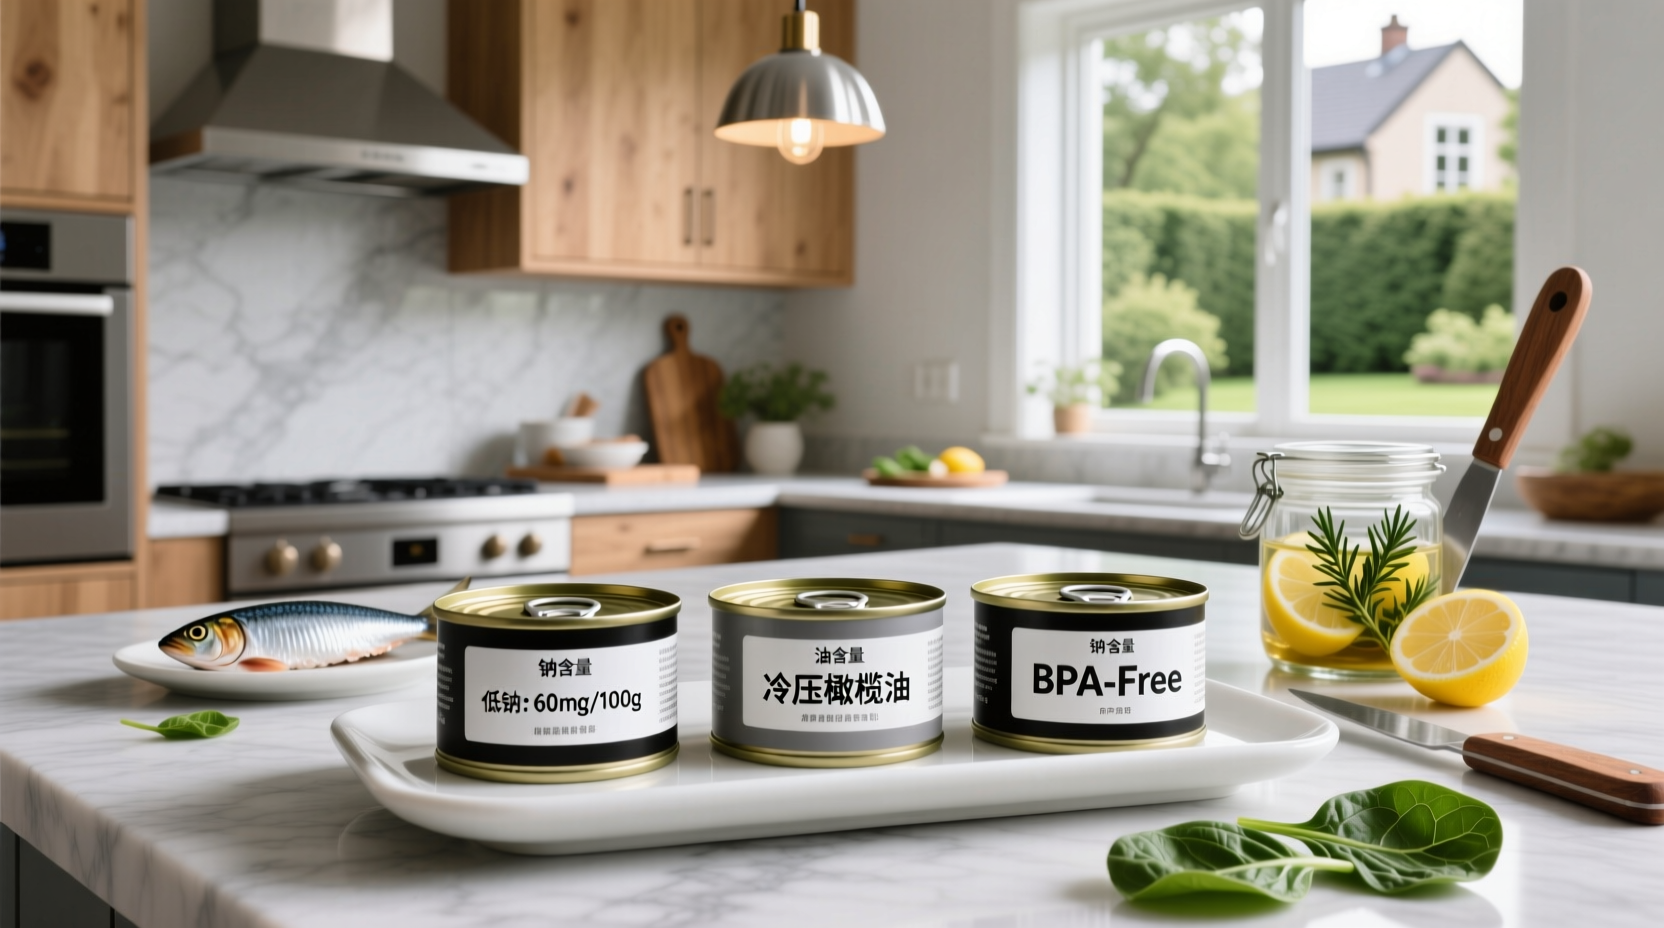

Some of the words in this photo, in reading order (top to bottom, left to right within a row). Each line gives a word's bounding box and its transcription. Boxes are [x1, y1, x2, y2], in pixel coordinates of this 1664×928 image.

[814, 646, 865, 665] 油含量
[1089, 637, 1135, 655] 钠含量
[538, 657, 592, 678] 钠含量
[762, 671, 910, 706] 冷压橄榄油
[1032, 663, 1182, 697] BPA-Free
[533, 689, 642, 717] 60mg/100g
